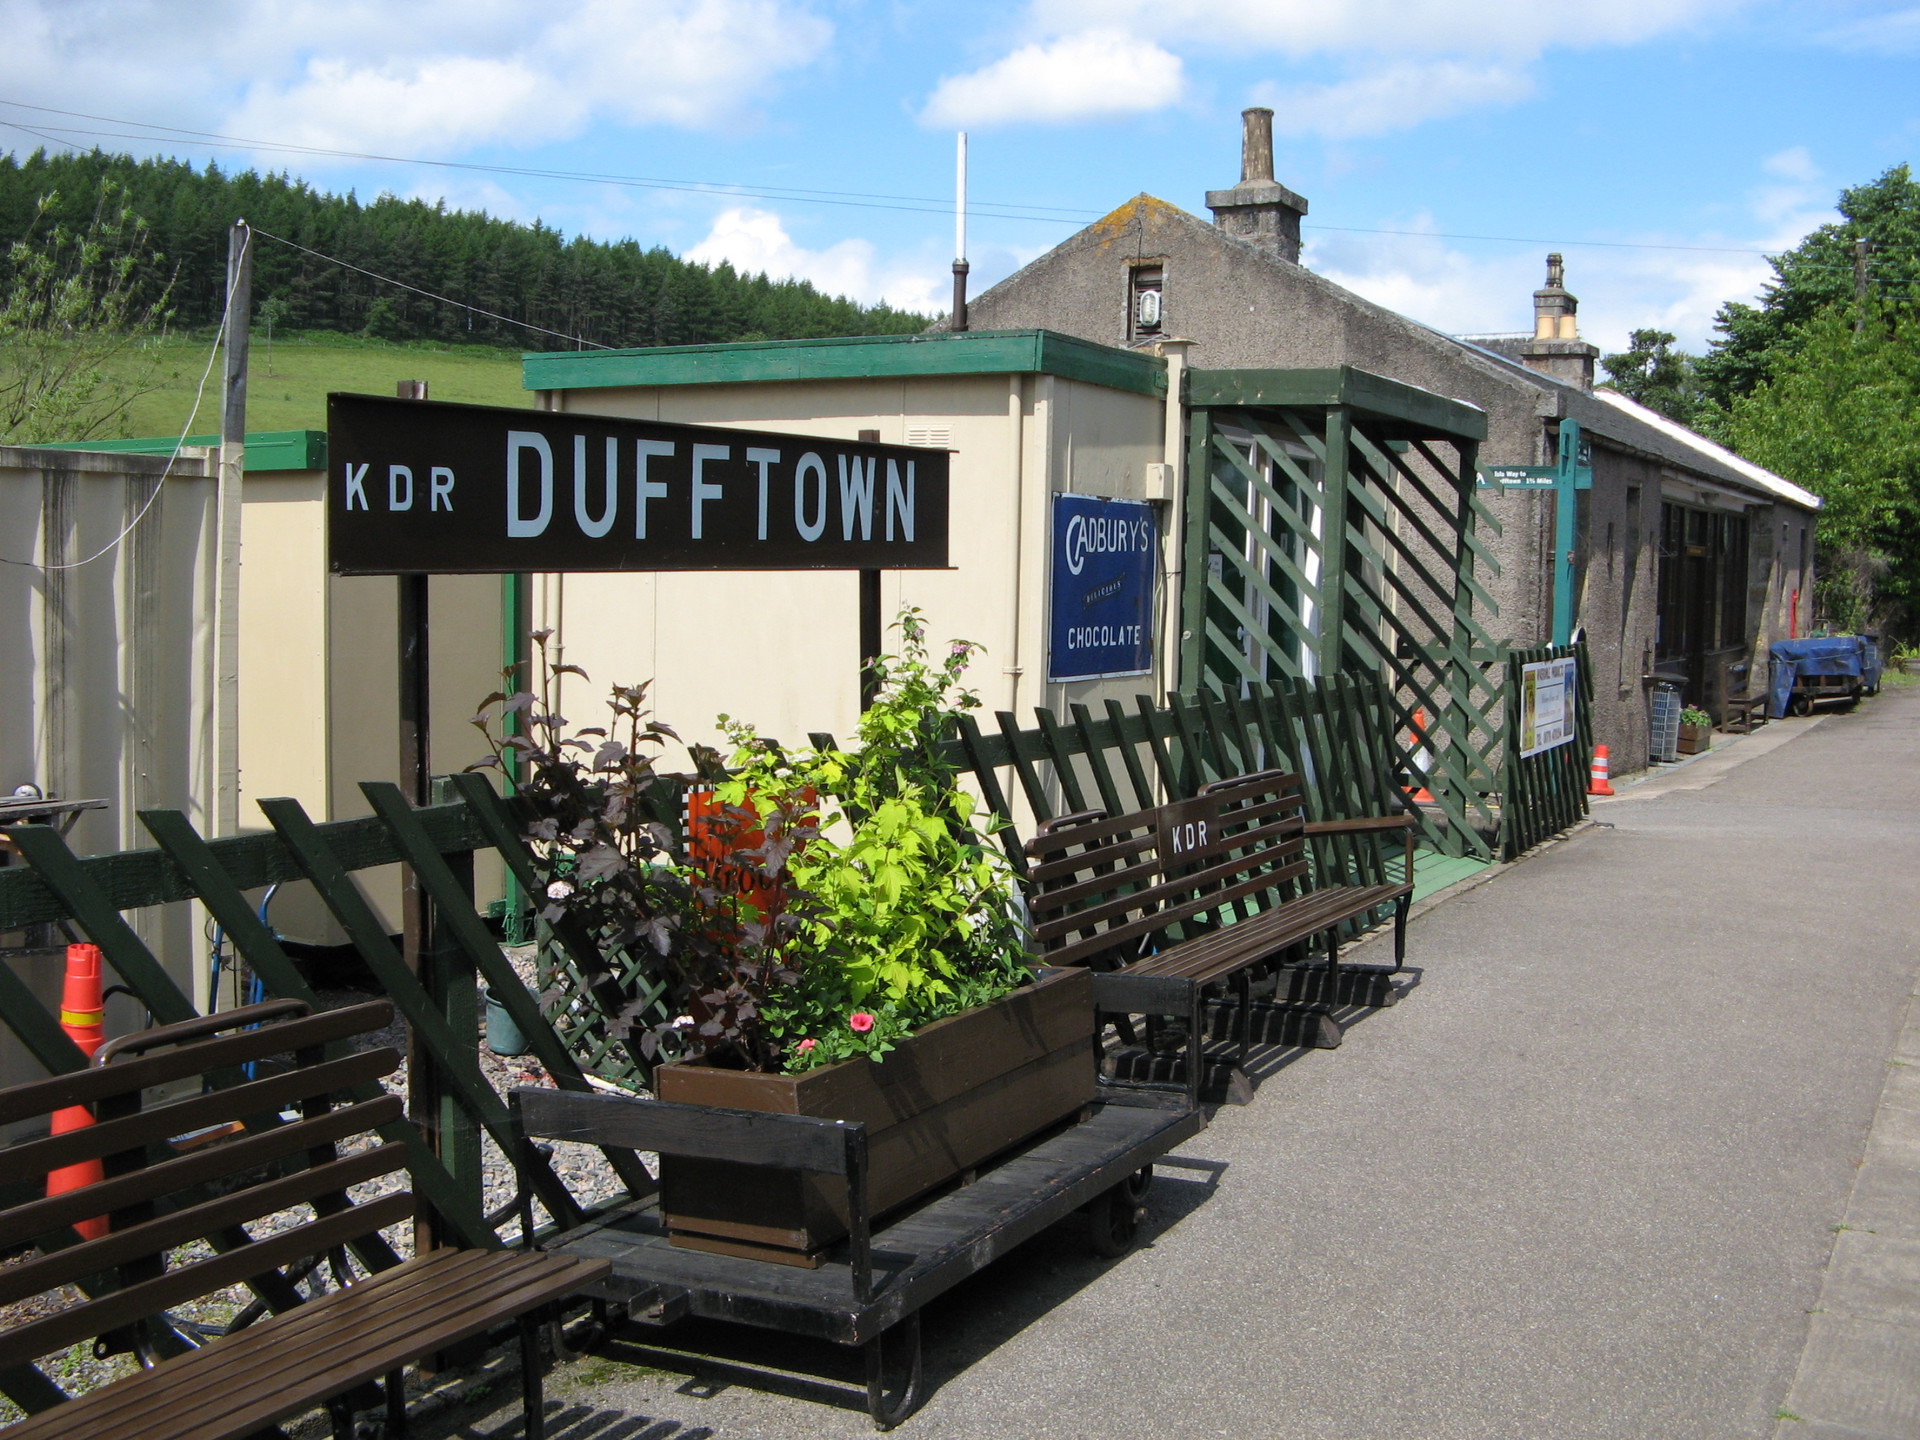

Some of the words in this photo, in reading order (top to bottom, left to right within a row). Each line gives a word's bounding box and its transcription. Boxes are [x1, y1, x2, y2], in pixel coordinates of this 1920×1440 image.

[507, 430, 916, 543] DUFFTOWN
[1506, 470, 1519, 478] Way
[1066, 514, 1149, 576] CADBURY'S
[1068, 625, 1141, 650] CHOCOLATE
[1172, 820, 1208, 854] KDR
